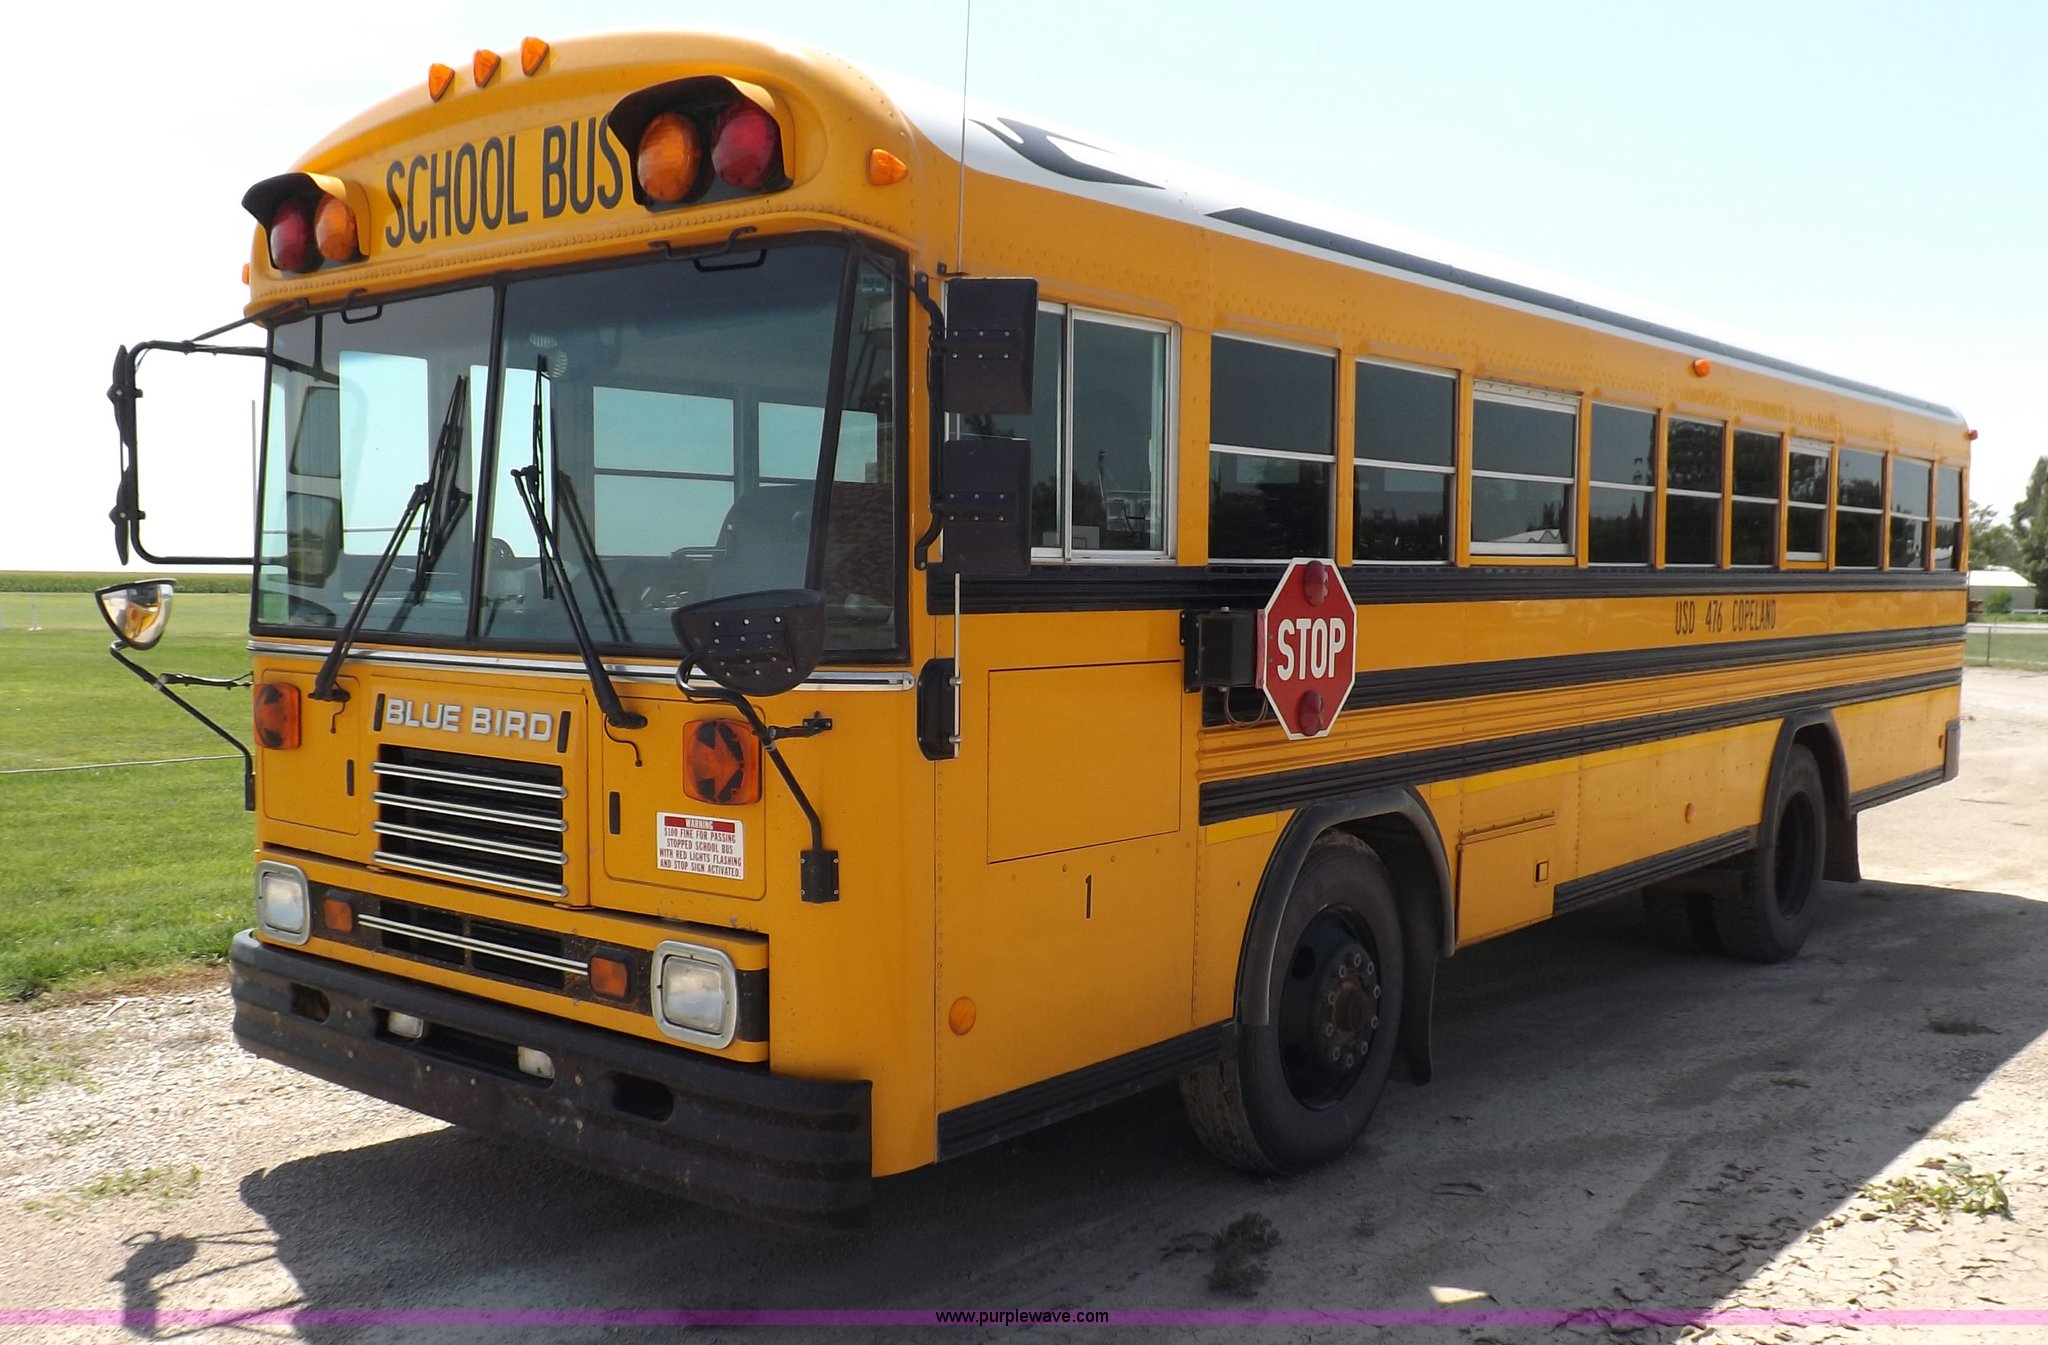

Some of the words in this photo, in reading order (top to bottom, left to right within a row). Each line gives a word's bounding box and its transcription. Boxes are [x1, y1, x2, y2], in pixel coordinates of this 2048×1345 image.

[385, 134, 528, 248] SCHOOL
[541, 114, 623, 219] BUS
[1675, 599, 1696, 635] USD
[1705, 600, 1723, 632] 476
[1732, 599, 1777, 632] COPELAND
[1276, 617, 1346, 682] STOP
[386, 699, 463, 732] BLUE
[471, 707, 554, 742] BIRD
[667, 838, 692, 849] STOPPED
[695, 841, 719, 853] SCHOOL
[721, 844, 733, 855] BUS
[680, 829, 693, 839] FINE
[696, 831, 708, 840] FOR
[710, 832, 736, 844] PASSING
[660, 848, 673, 858] WITH
[676, 850, 687, 860] RED
[690, 852, 710, 863] LIGHTS
[713, 855, 742, 867] FLASHING
[660, 859, 672, 868] AND
[674, 860, 689, 871] STOP
[691, 862, 705, 872] SIGN
[1084, 874, 1092, 919] 1
